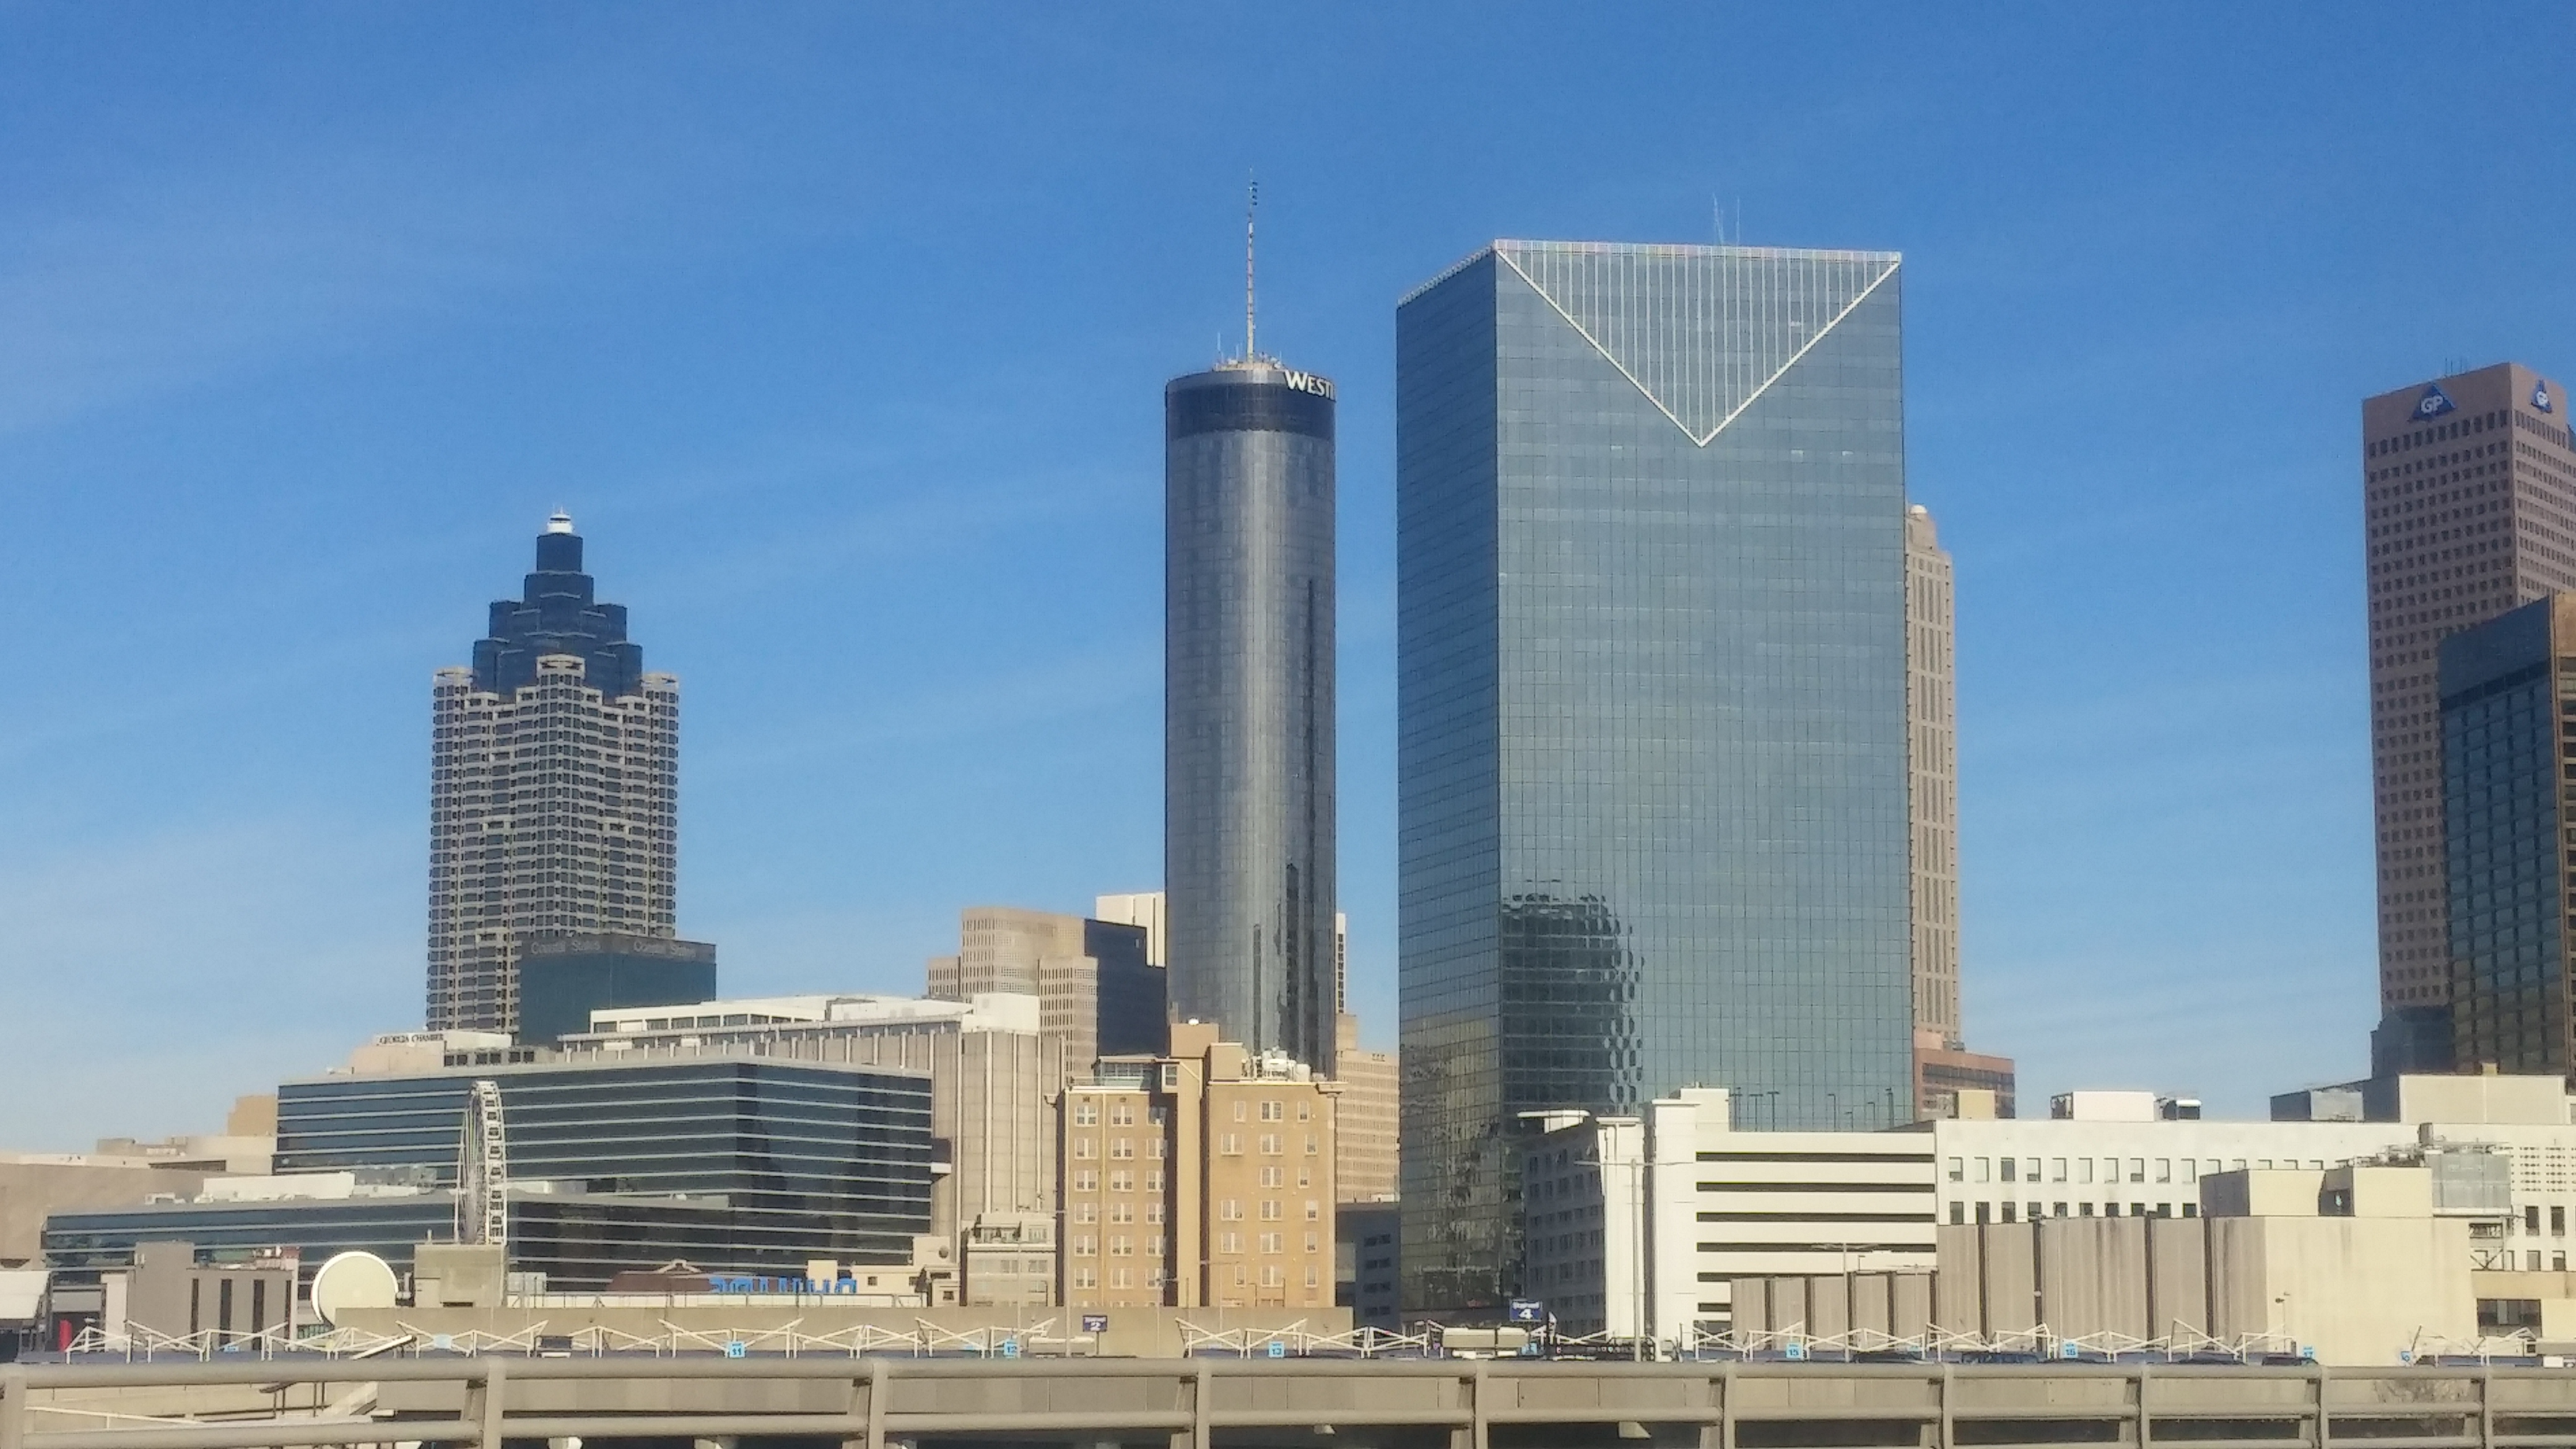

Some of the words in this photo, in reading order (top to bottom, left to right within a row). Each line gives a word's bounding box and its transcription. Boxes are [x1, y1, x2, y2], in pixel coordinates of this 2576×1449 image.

[2420, 395, 2444, 414] GP
[1519, 1308, 1533, 1320] 4
[1090, 1321, 1101, 1331] 2
